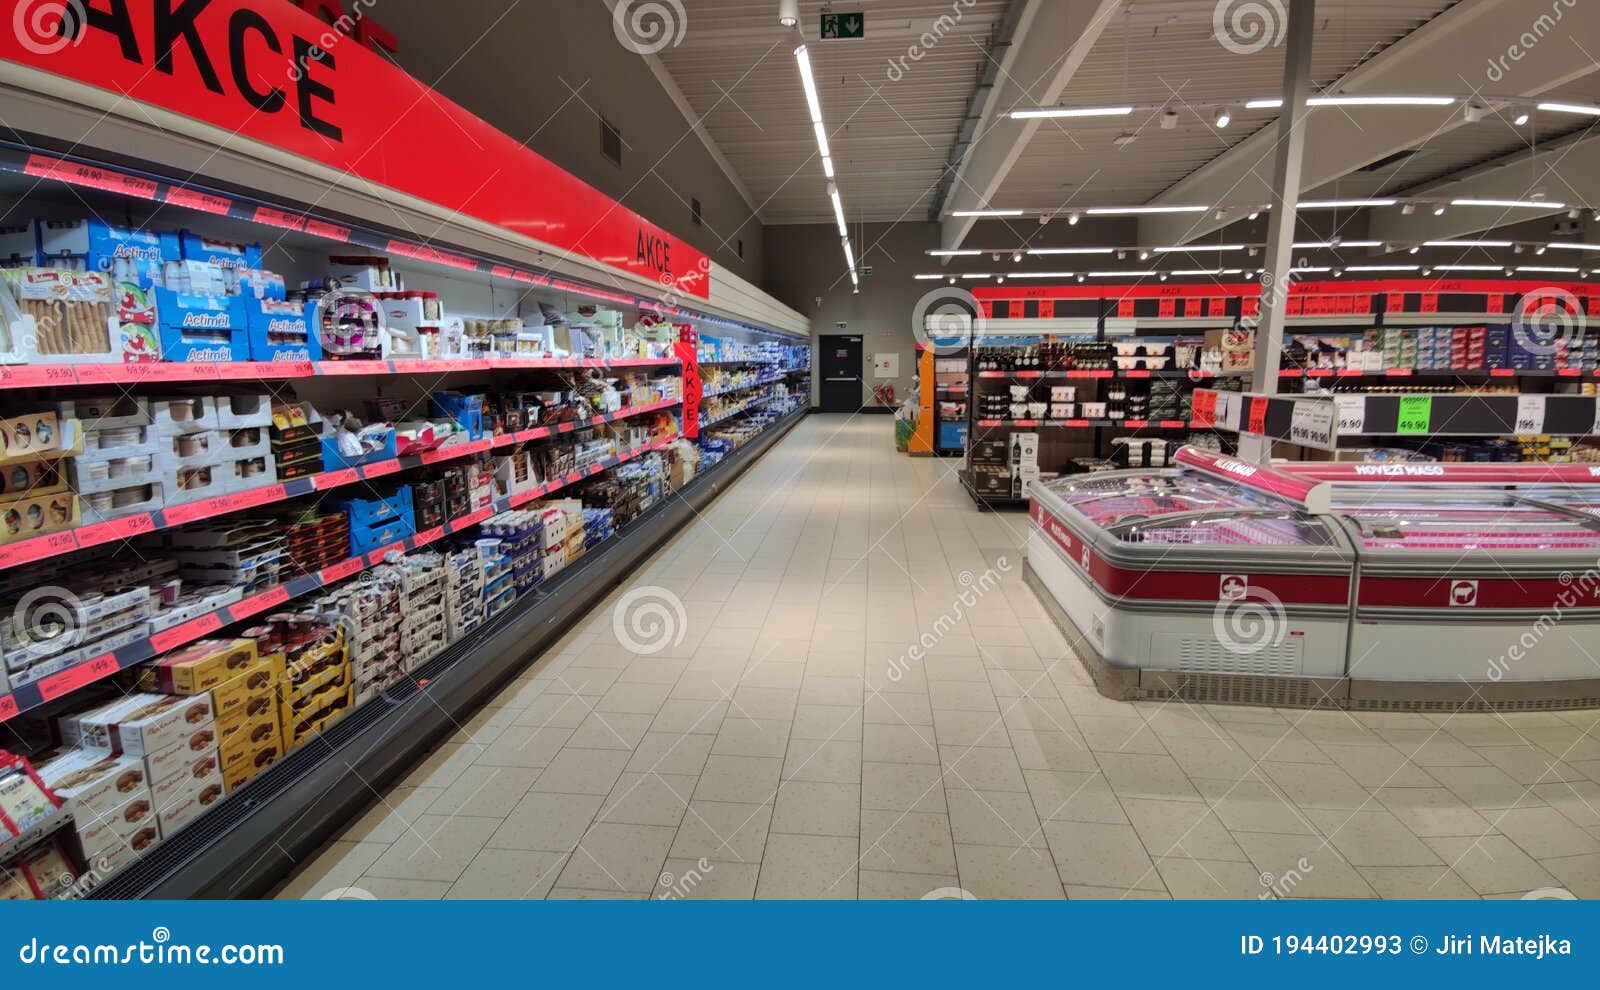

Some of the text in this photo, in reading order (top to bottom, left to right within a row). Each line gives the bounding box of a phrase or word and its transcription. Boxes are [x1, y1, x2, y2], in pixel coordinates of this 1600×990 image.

[114, 243, 161, 260] Actimel
[636, 229, 672, 274] AKCE
[207, 255, 248, 269] Actimel
[183, 311, 230, 328] Actimel
[268, 318, 307, 333] Actimel
[186, 346, 232, 361] Actimel
[272, 349, 310, 362] Actimel
[685, 362, 695, 421] AKCE
[1400, 420, 1427, 431] 49.90
[1406, 465, 1444, 476] MASO
